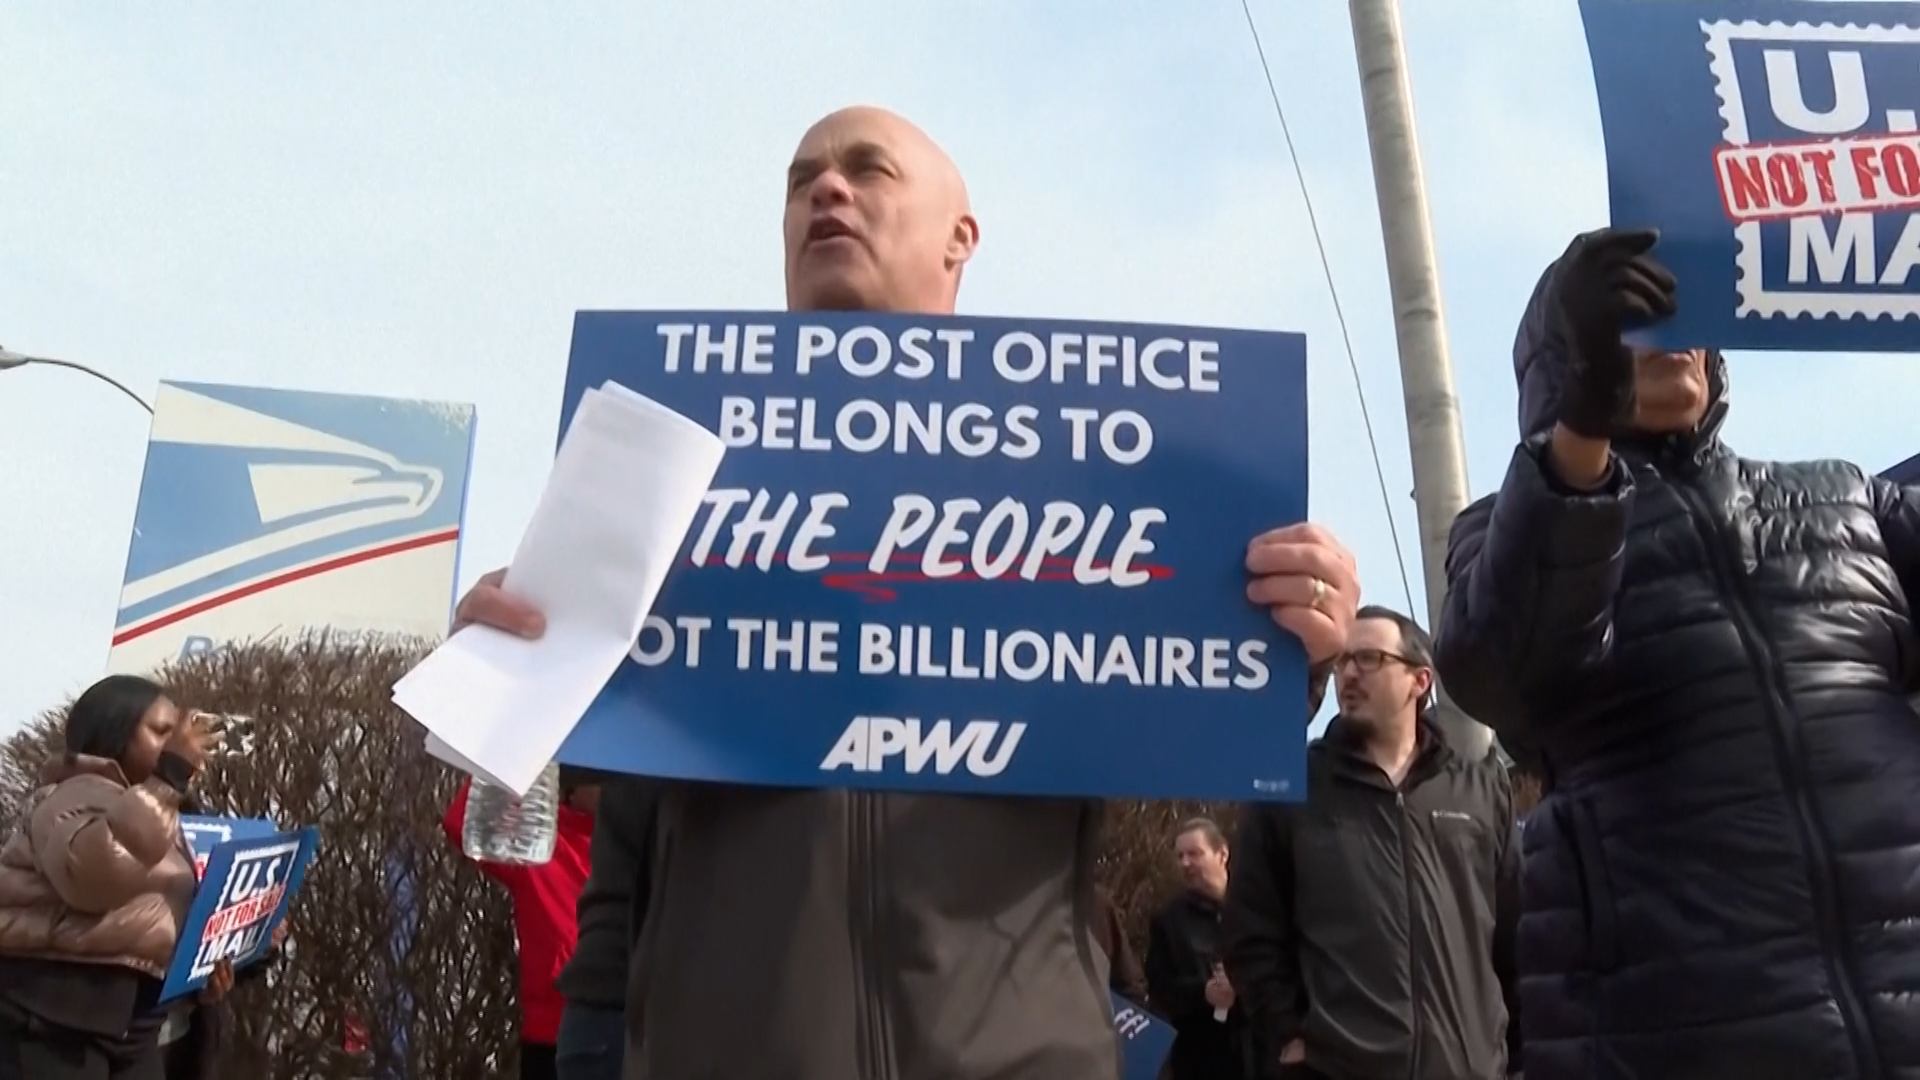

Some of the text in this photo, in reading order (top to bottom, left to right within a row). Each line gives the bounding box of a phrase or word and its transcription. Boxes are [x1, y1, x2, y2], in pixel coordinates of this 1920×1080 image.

[1725, 143, 1920, 211] NOT FO
[657, 324, 1220, 393] THE POST OFFICE
[718, 397, 1154, 465] BELONGS TO
[690, 487, 1167, 587] THE PEOPLE
[628, 615, 1270, 689] OT THE BILLIONAIRES
[819, 716, 1027, 777] APWU
[203, 924, 259, 965] MAIL
[205, 910, 233, 939] NOT
[233, 898, 259, 926] FOR
[1113, 1007, 1150, 1040] FF!
